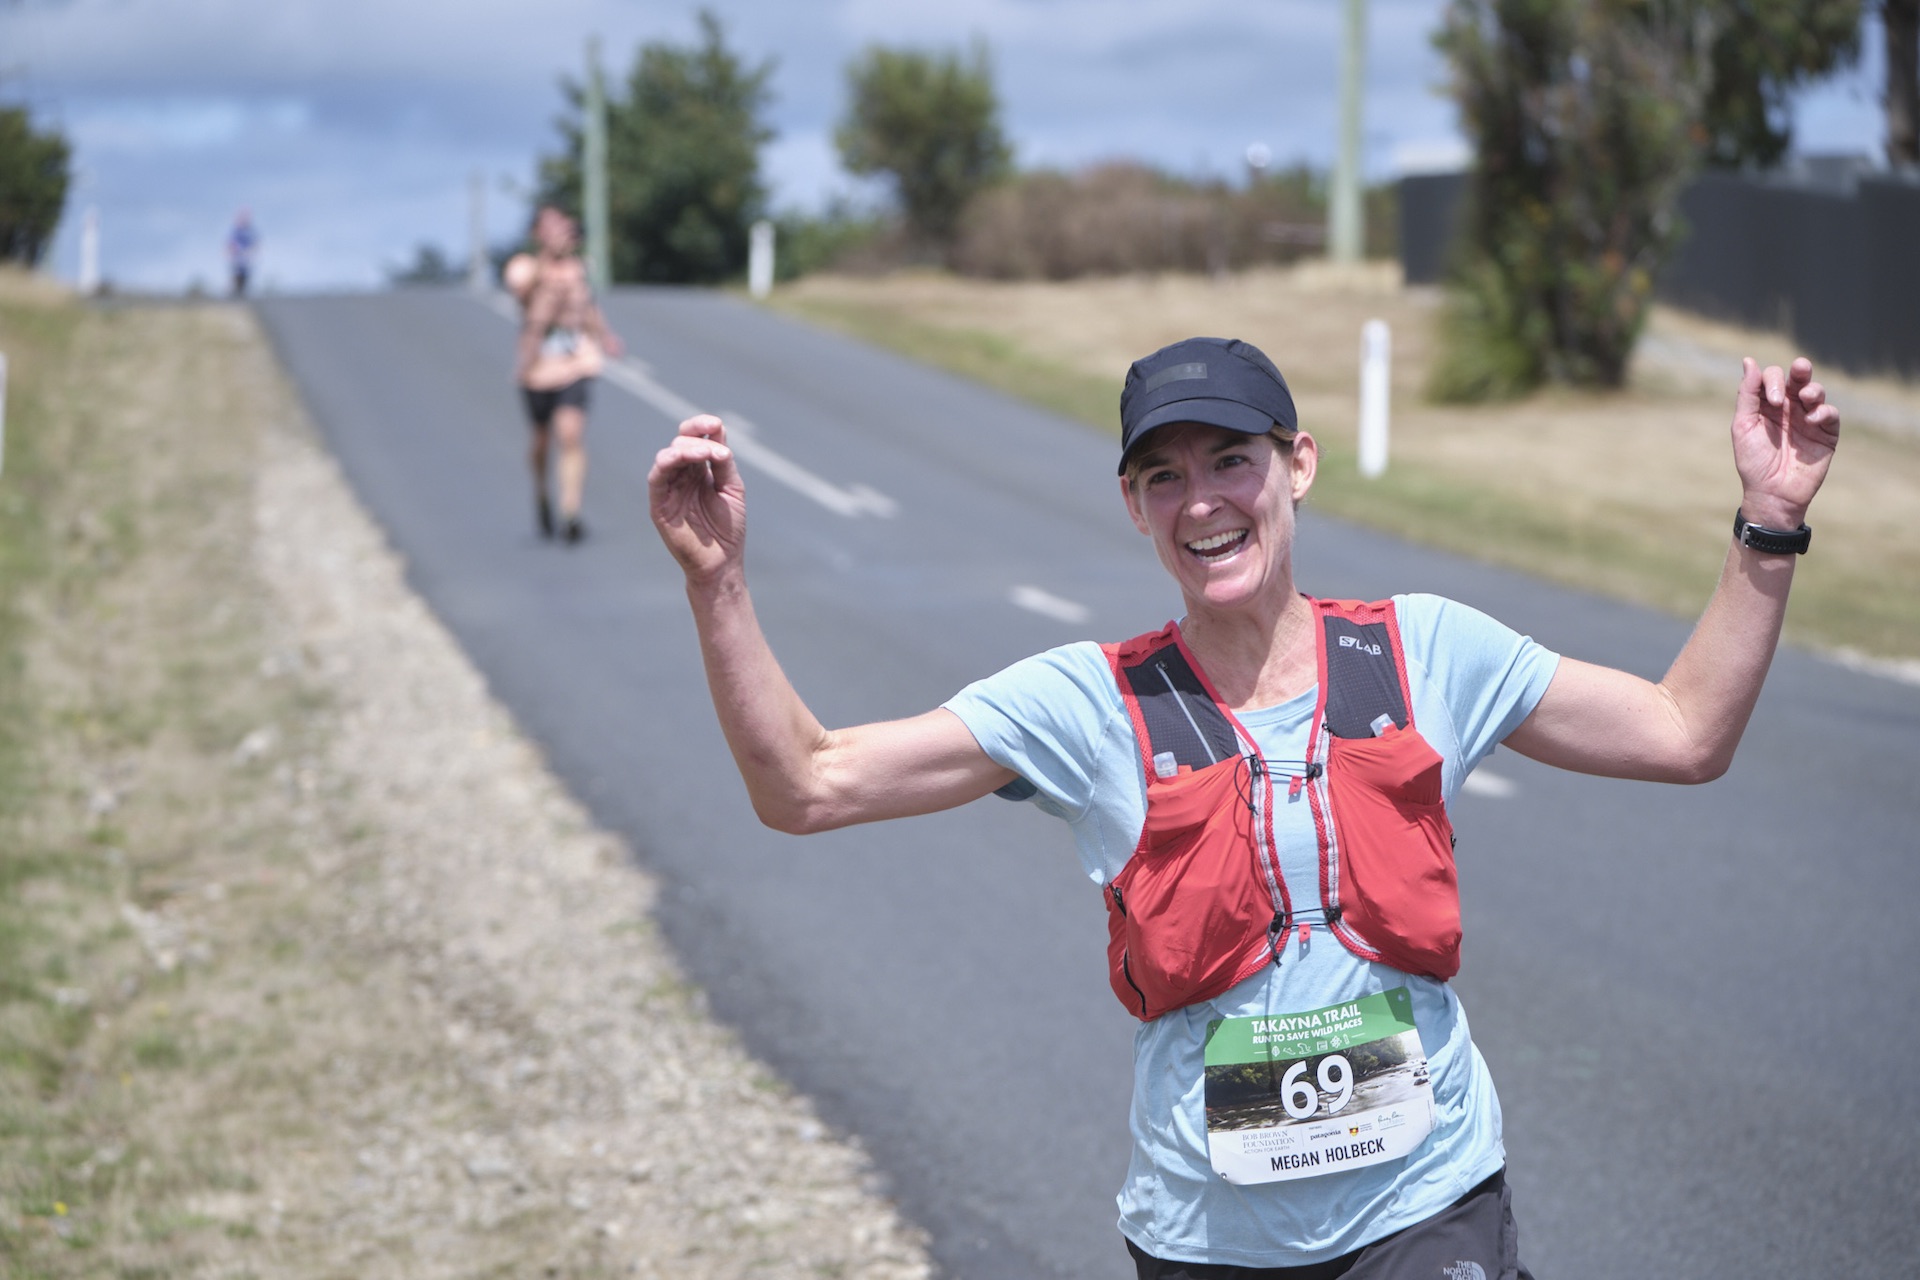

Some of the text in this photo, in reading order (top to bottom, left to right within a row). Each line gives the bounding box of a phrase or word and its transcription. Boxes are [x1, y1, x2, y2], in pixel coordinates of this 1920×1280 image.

[1251, 1004, 1361, 1033] TAKAYNA TRAIL
[1252, 1017, 1363, 1044] RUN TO SAVE WILD PLACES
[1281, 1054, 1354, 1120] 69
[1242, 1130, 1288, 1141] BOB BROWN
[1243, 1136, 1295, 1149] FOUNDATION
[1310, 1129, 1341, 1141] patagonia
[1270, 1137, 1385, 1171] MEGAN HOLBECK
[1443, 1267, 1473, 1275] NORTH
